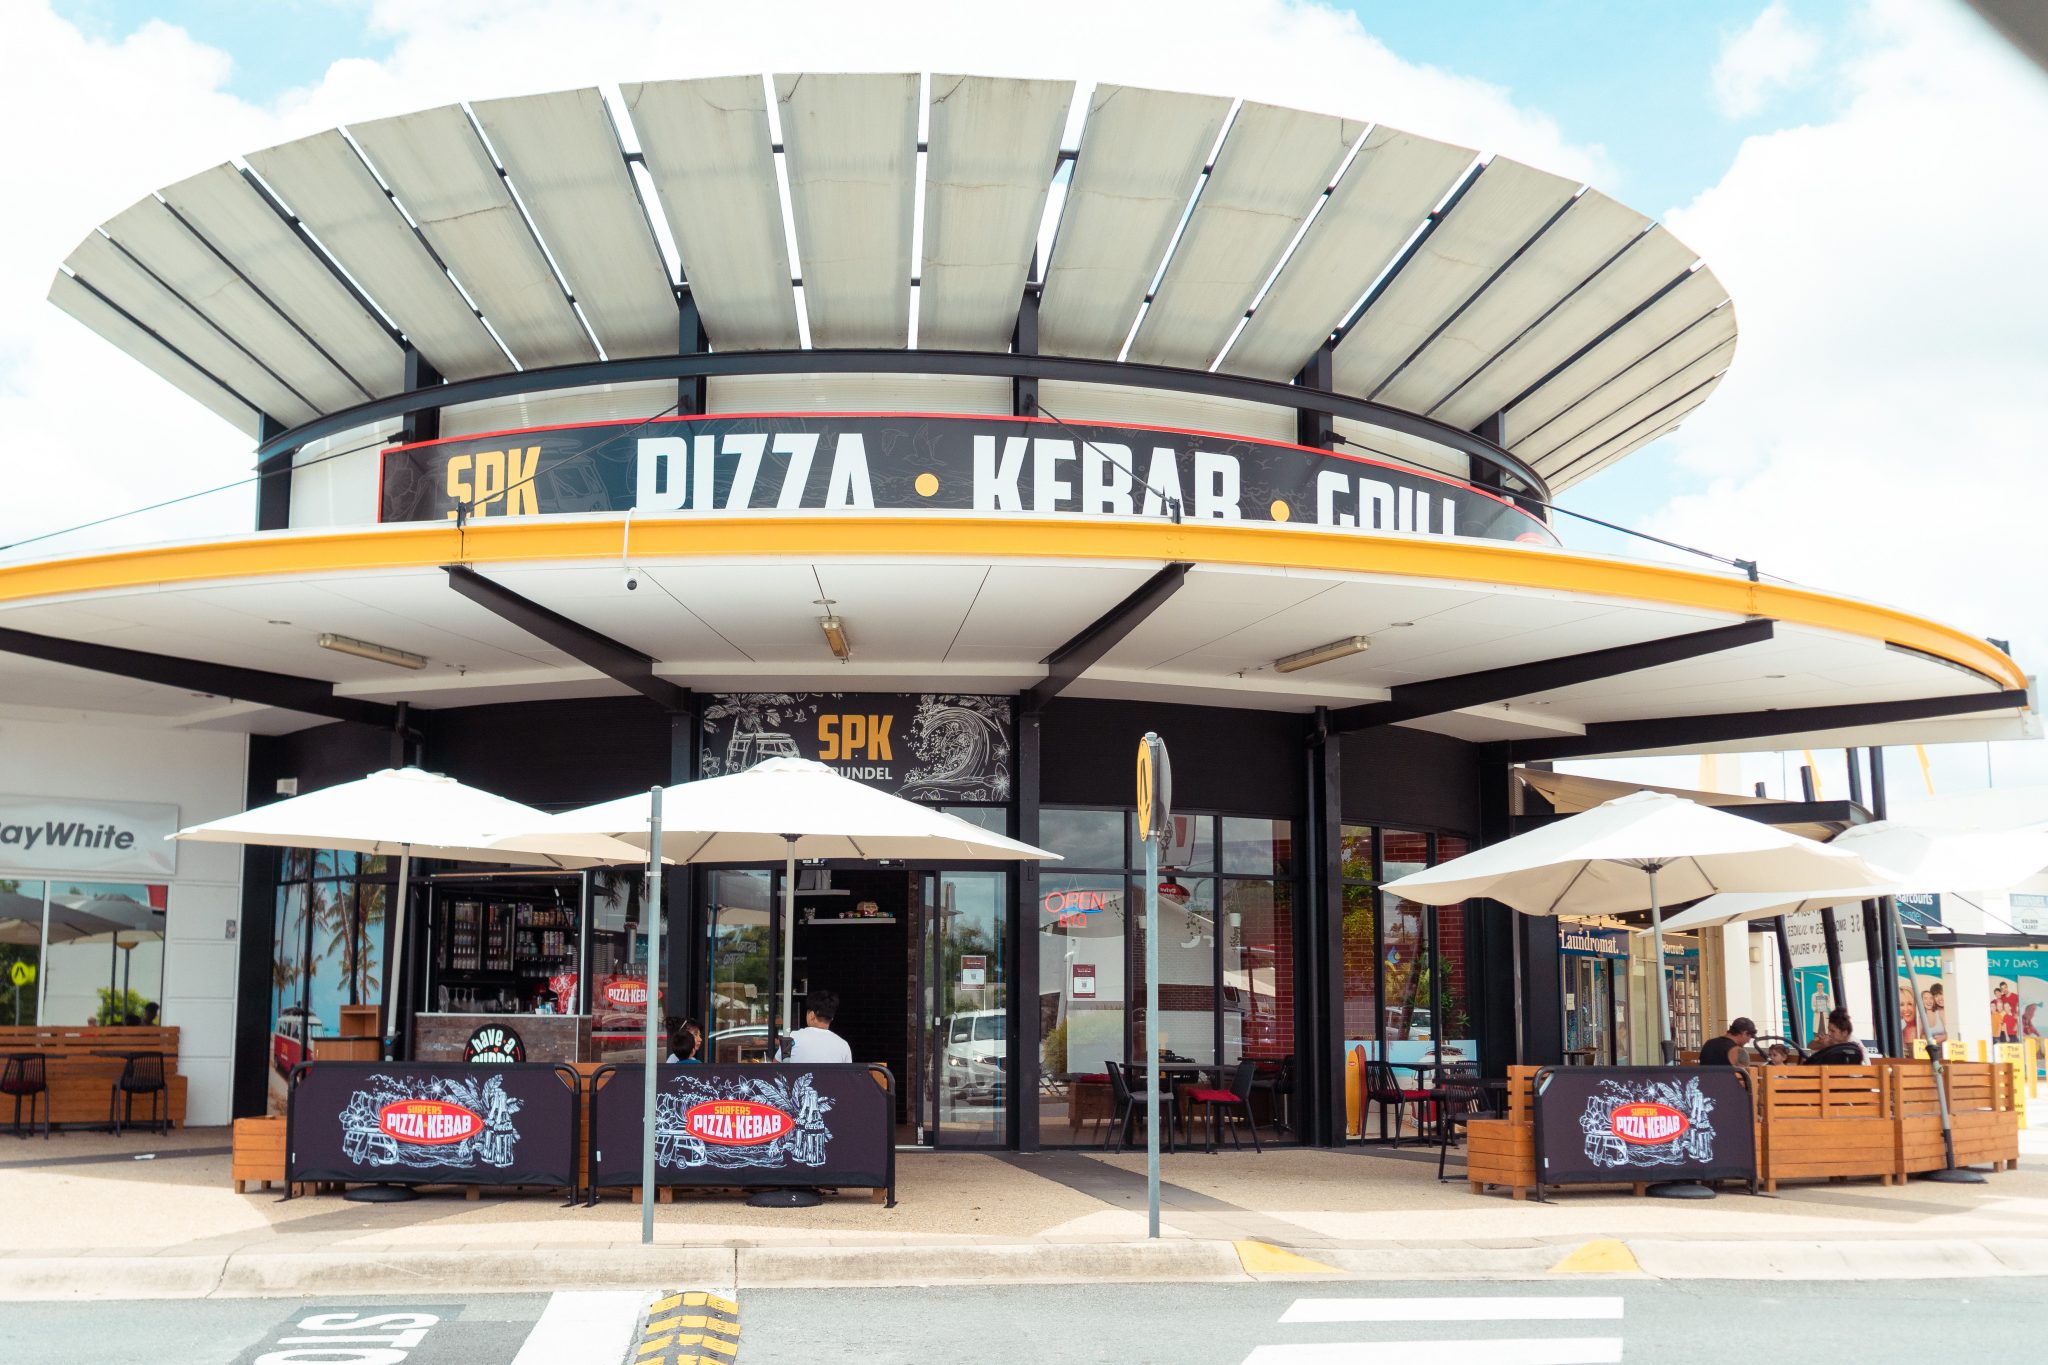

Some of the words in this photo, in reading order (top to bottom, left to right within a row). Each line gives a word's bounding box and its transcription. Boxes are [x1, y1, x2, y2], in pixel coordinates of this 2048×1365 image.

[446, 446, 541, 519] SPK
[635, 432, 875, 510] PIZZA
[972, 434, 1242, 520] KEBAB
[817, 713, 894, 761] SPK
[831, 766, 893, 780] UNDEL
[0, 821, 135, 850] ayWhite
[1044, 890, 1106, 914] OPEN
[1896, 893, 1933, 905] arcourts
[1058, 913, 1087, 928] BYO
[2004, 959, 2010, 968] 7
[2013, 959, 2040, 968] DAYS
[608, 988, 629, 1002] PIZZA
[631, 988, 648, 1003] KEB
[471, 1029, 504, 1053] have
[503, 1037, 516, 1055] a
[407, 1105, 442, 1114] SURFERS
[714, 1105, 751, 1115] SURFERS
[386, 1113, 424, 1138] PIZZA
[427, 1114, 472, 1138] KEBAB
[693, 1114, 733, 1138] PIZZA
[736, 1114, 782, 1139] KEBAB
[1616, 1116, 1647, 1138] PIZZA
[1647, 1115, 1681, 1139] KEBAB
